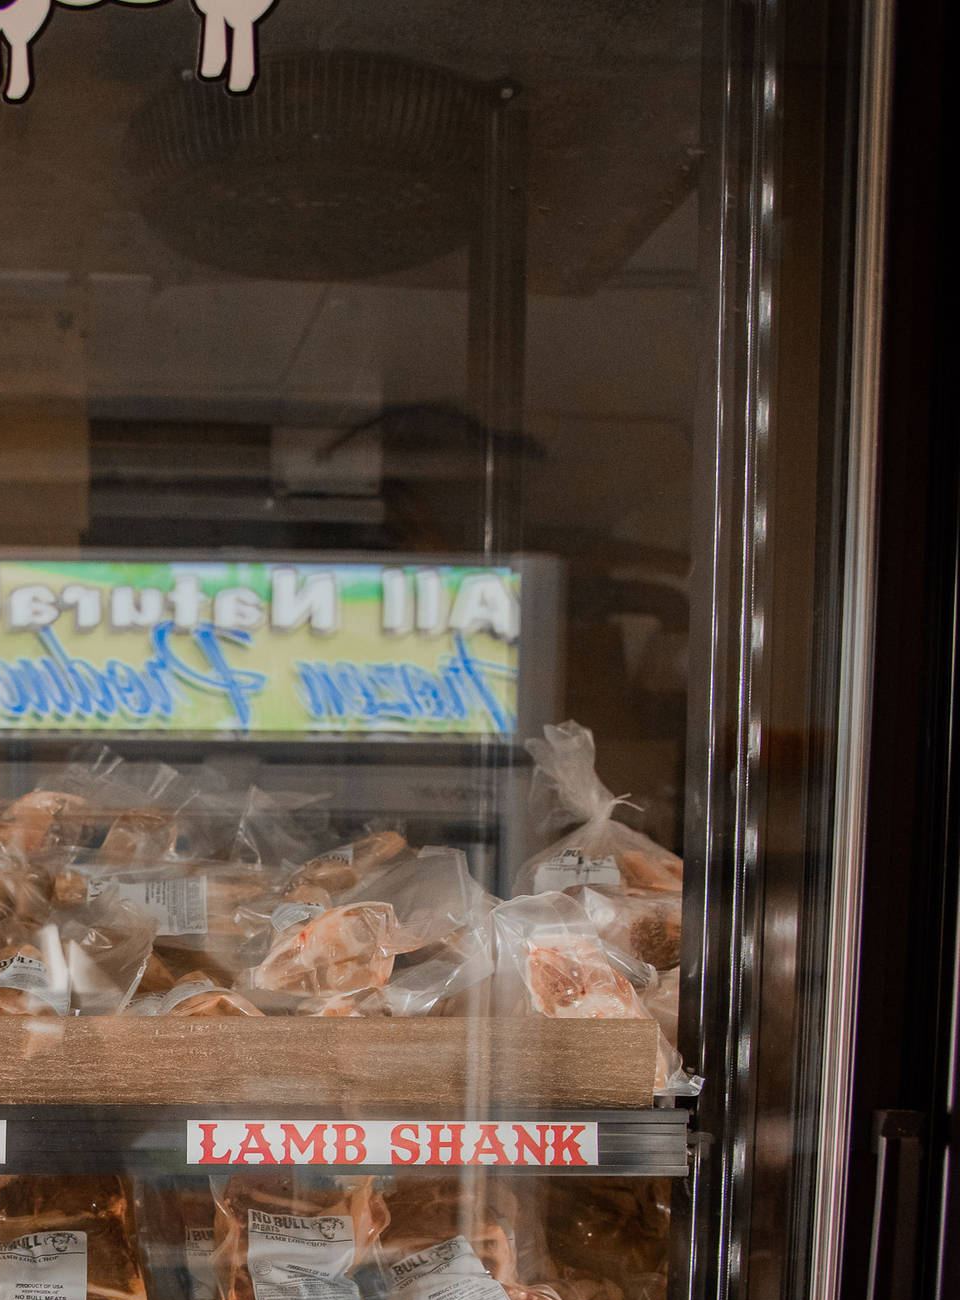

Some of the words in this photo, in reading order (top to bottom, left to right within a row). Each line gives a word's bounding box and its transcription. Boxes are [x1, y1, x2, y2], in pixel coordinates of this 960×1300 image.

[198, 1123, 367, 1165] LAMB
[390, 1123, 588, 1166] SHANK
[251, 1211, 271, 1225] NO
[273, 1216, 310, 1230] BULL
[392, 1254, 429, 1276] BULL
